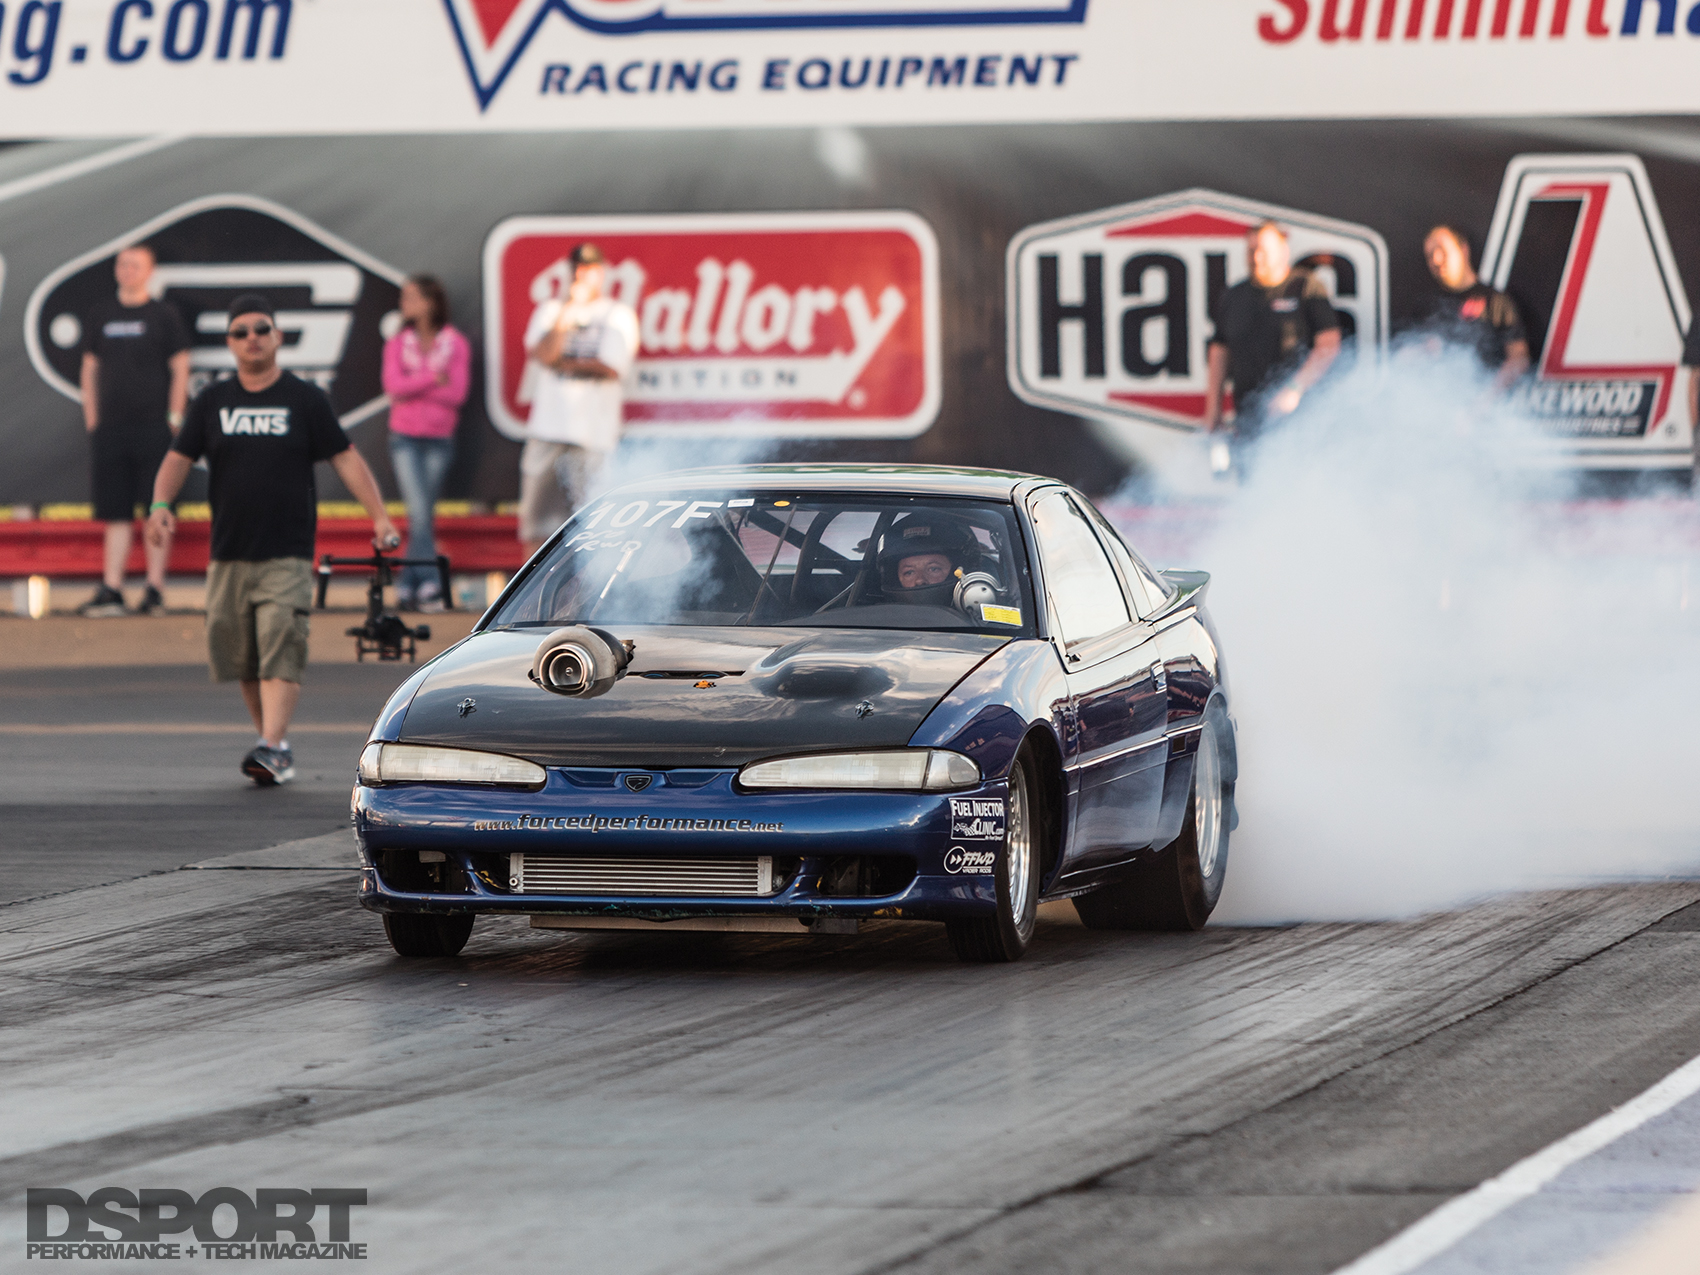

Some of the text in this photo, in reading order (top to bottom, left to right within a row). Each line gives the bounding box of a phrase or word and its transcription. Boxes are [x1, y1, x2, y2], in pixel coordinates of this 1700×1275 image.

[0, 0, 293, 86] g.com
[539, 54, 1080, 95] RACING EQUIPMENT
[637, 367, 798, 390] NITION
[219, 407, 290, 435] VANS
[584, 499, 725, 530] 107F
[473, 813, 784, 833] www.forcedperformance.net
